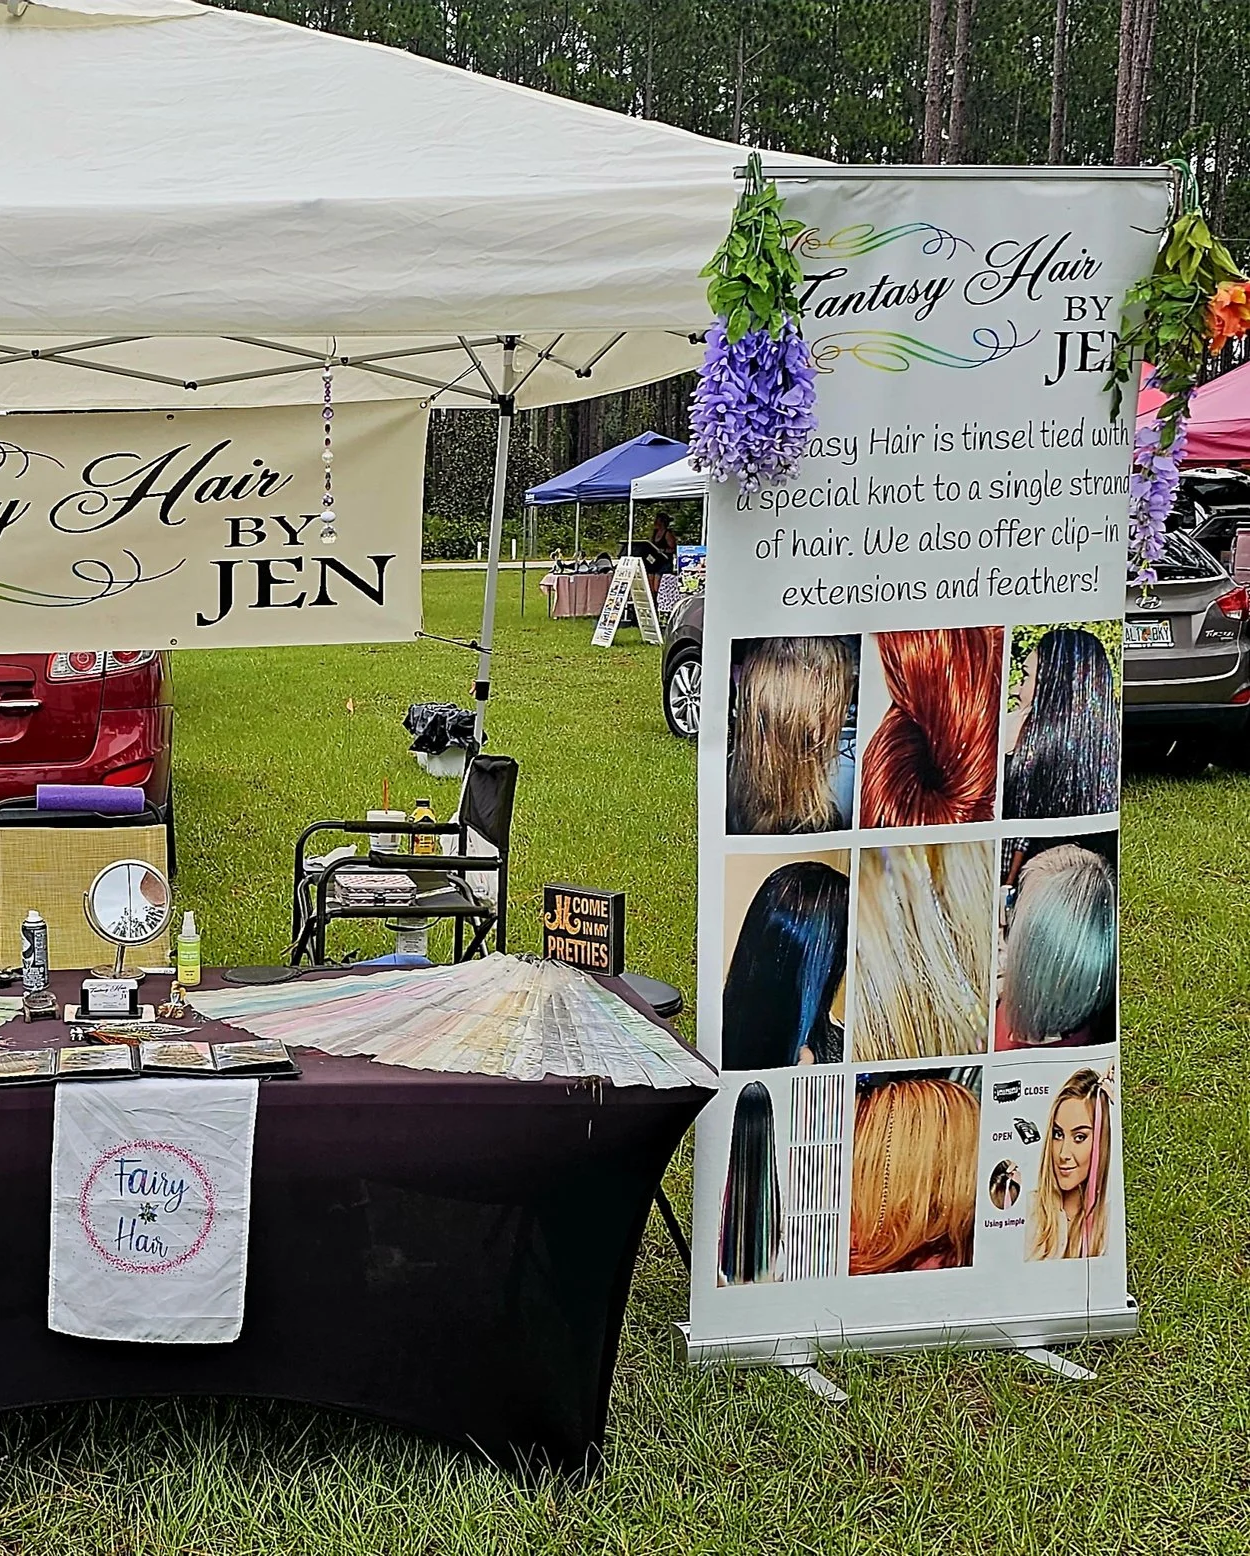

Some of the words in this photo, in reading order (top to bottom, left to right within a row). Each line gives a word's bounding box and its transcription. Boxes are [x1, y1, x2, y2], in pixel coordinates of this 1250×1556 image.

[963, 231, 1102, 305] Hair
[1063, 296, 1113, 321] BY
[870, 425, 925, 454] Hair
[935, 424, 953, 451] is
[962, 421, 1034, 450] tinsel
[1040, 417, 1084, 447] tied
[1092, 419, 1129, 446] with
[49, 439, 295, 534] Hair
[759, 477, 860, 517] special
[868, 475, 925, 505] knot
[933, 474, 960, 501] to
[969, 481, 982, 500] a
[989, 470, 1062, 505] single
[1070, 465, 1130, 496] strand
[224, 514, 324, 549] BY
[756, 529, 785, 558] of
[793, 528, 853, 556] hair.
[865, 527, 909, 555] We
[920, 523, 970, 551] also
[979, 519, 1045, 548] offer
[1052, 516, 1118, 552] clip-in
[196, 554, 398, 626] JEN
[783, 575, 926, 605] extensions
[937, 567, 979, 599] and
[987, 566, 1098, 596] feathers!
[573, 897, 608, 917] COME
[583, 921, 592, 935] IN
[594, 923, 608, 937] MY
[548, 935, 608, 967] PRETTIES
[1024, 1086, 1049, 1095] CLOSE
[993, 1132, 1012, 1142] OPEN
[115, 1158, 189, 1213] Fairy
[114, 1217, 168, 1258] Hair
[985, 1219, 1003, 1228] Using
[1005, 1218, 1025, 1227] simple
